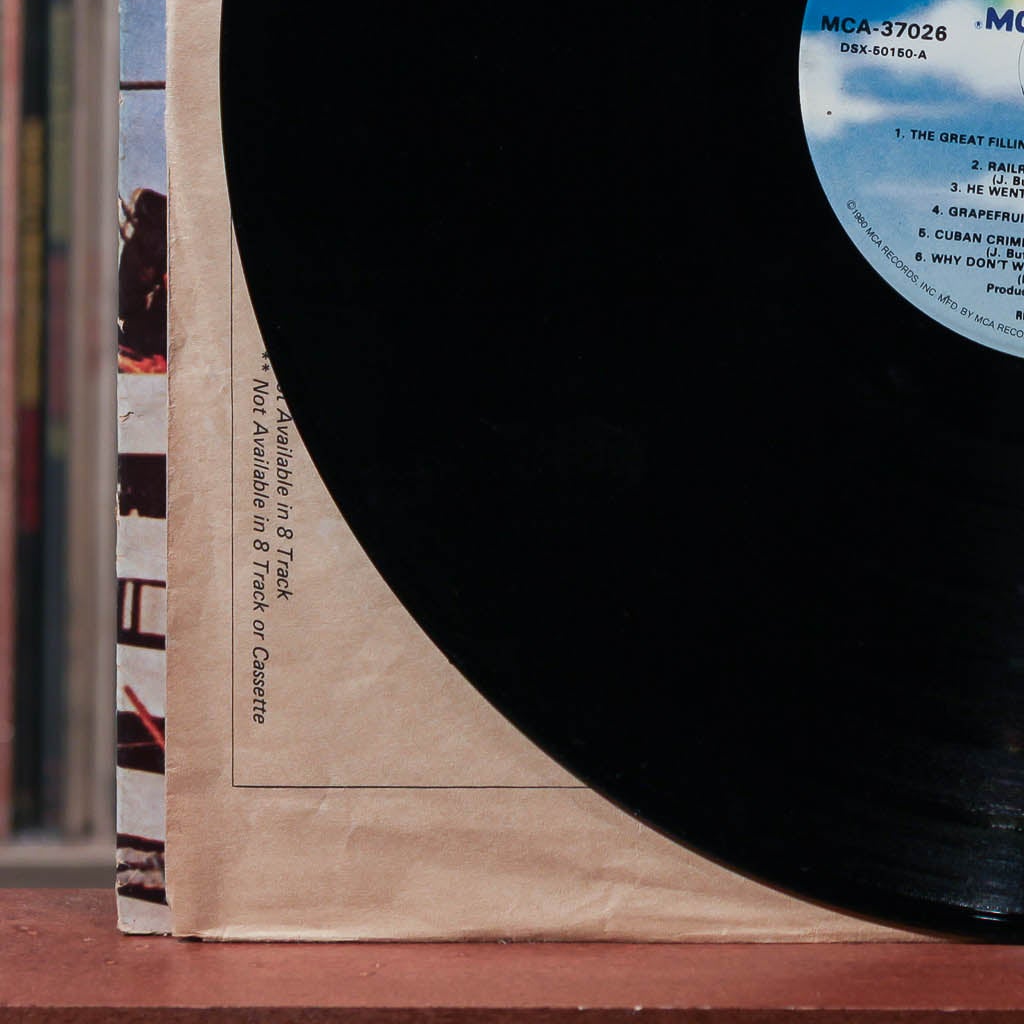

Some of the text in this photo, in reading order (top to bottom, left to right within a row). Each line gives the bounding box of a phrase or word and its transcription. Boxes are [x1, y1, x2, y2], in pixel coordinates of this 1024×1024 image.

[820, 15, 947, 42] MCA-37026
[840, 42, 927, 60] DSX-50150-A
[895, 128, 905, 139] 1.
[910, 129, 935, 141] THE
[939, 132, 985, 146] GREAT
[971, 160, 983, 171] 2.
[950, 182, 962, 193] 3.
[967, 183, 984, 195] HE
[993, 174, 1007, 186] (J.
[932, 205, 944, 216] 4.
[918, 228, 930, 239] 5.
[934, 229, 982, 243] CUBAN
[915, 252, 926, 263] 6.
[931, 253, 962, 265] WHY
[966, 257, 1008, 270] DON'T
[986, 247, 1000, 257] (J.
[865, 227, 882, 248] MCA
[960, 307, 974, 318] BY
[974, 314, 995, 329] MCA
[276, 408, 293, 496] Available
[277, 502, 293, 520] in
[276, 526, 293, 540] 8
[252, 378, 269, 725] Not Available in 8 Track or Cassette
[276, 547, 293, 601] Track
